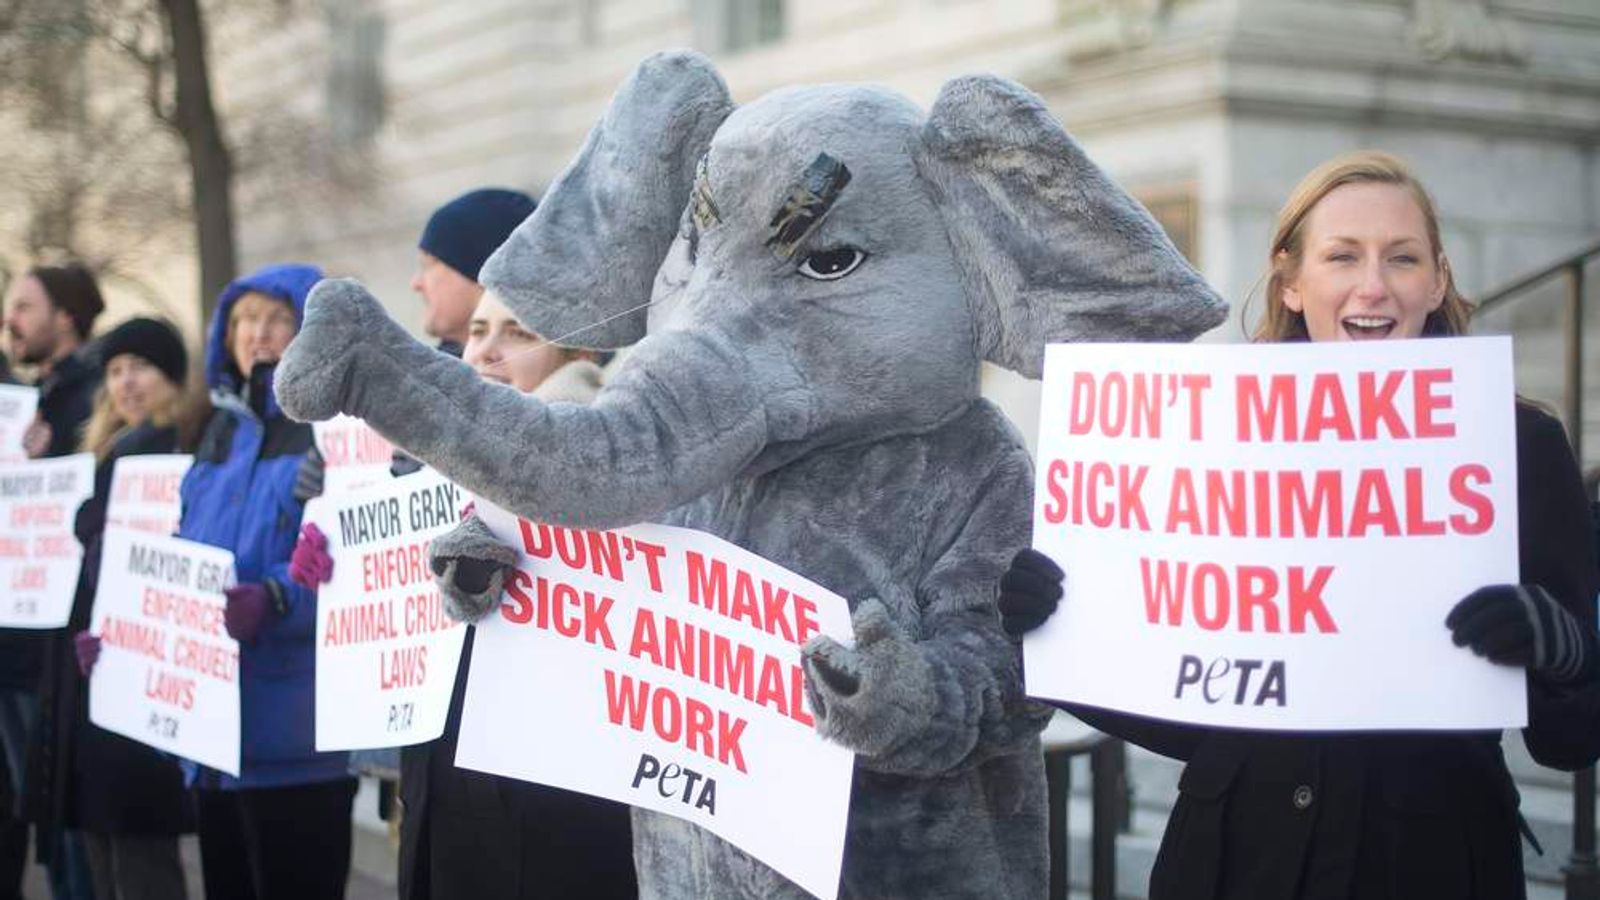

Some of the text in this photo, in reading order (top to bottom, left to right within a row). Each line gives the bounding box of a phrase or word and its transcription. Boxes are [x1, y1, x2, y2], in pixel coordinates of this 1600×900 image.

[1068, 368, 1457, 443] DON'T MAKE
[338, 497, 401, 548] MAYOR
[1044, 458, 1495, 539] SICK ANIMALS
[128, 543, 192, 587] MAYOR
[362, 540, 433, 592] ENFORC
[518, 517, 820, 646] DON'T MAKE
[143, 587, 226, 636] ENFORCE
[1139, 557, 1339, 635] WORK
[101, 617, 166, 662] ANIMAL
[324, 599, 398, 647] ANIMAL
[501, 567, 814, 729] SICK ANIMAL
[145, 666, 196, 711] LAWS
[380, 646, 428, 690] LAWS
[604, 669, 748, 774] WORK
